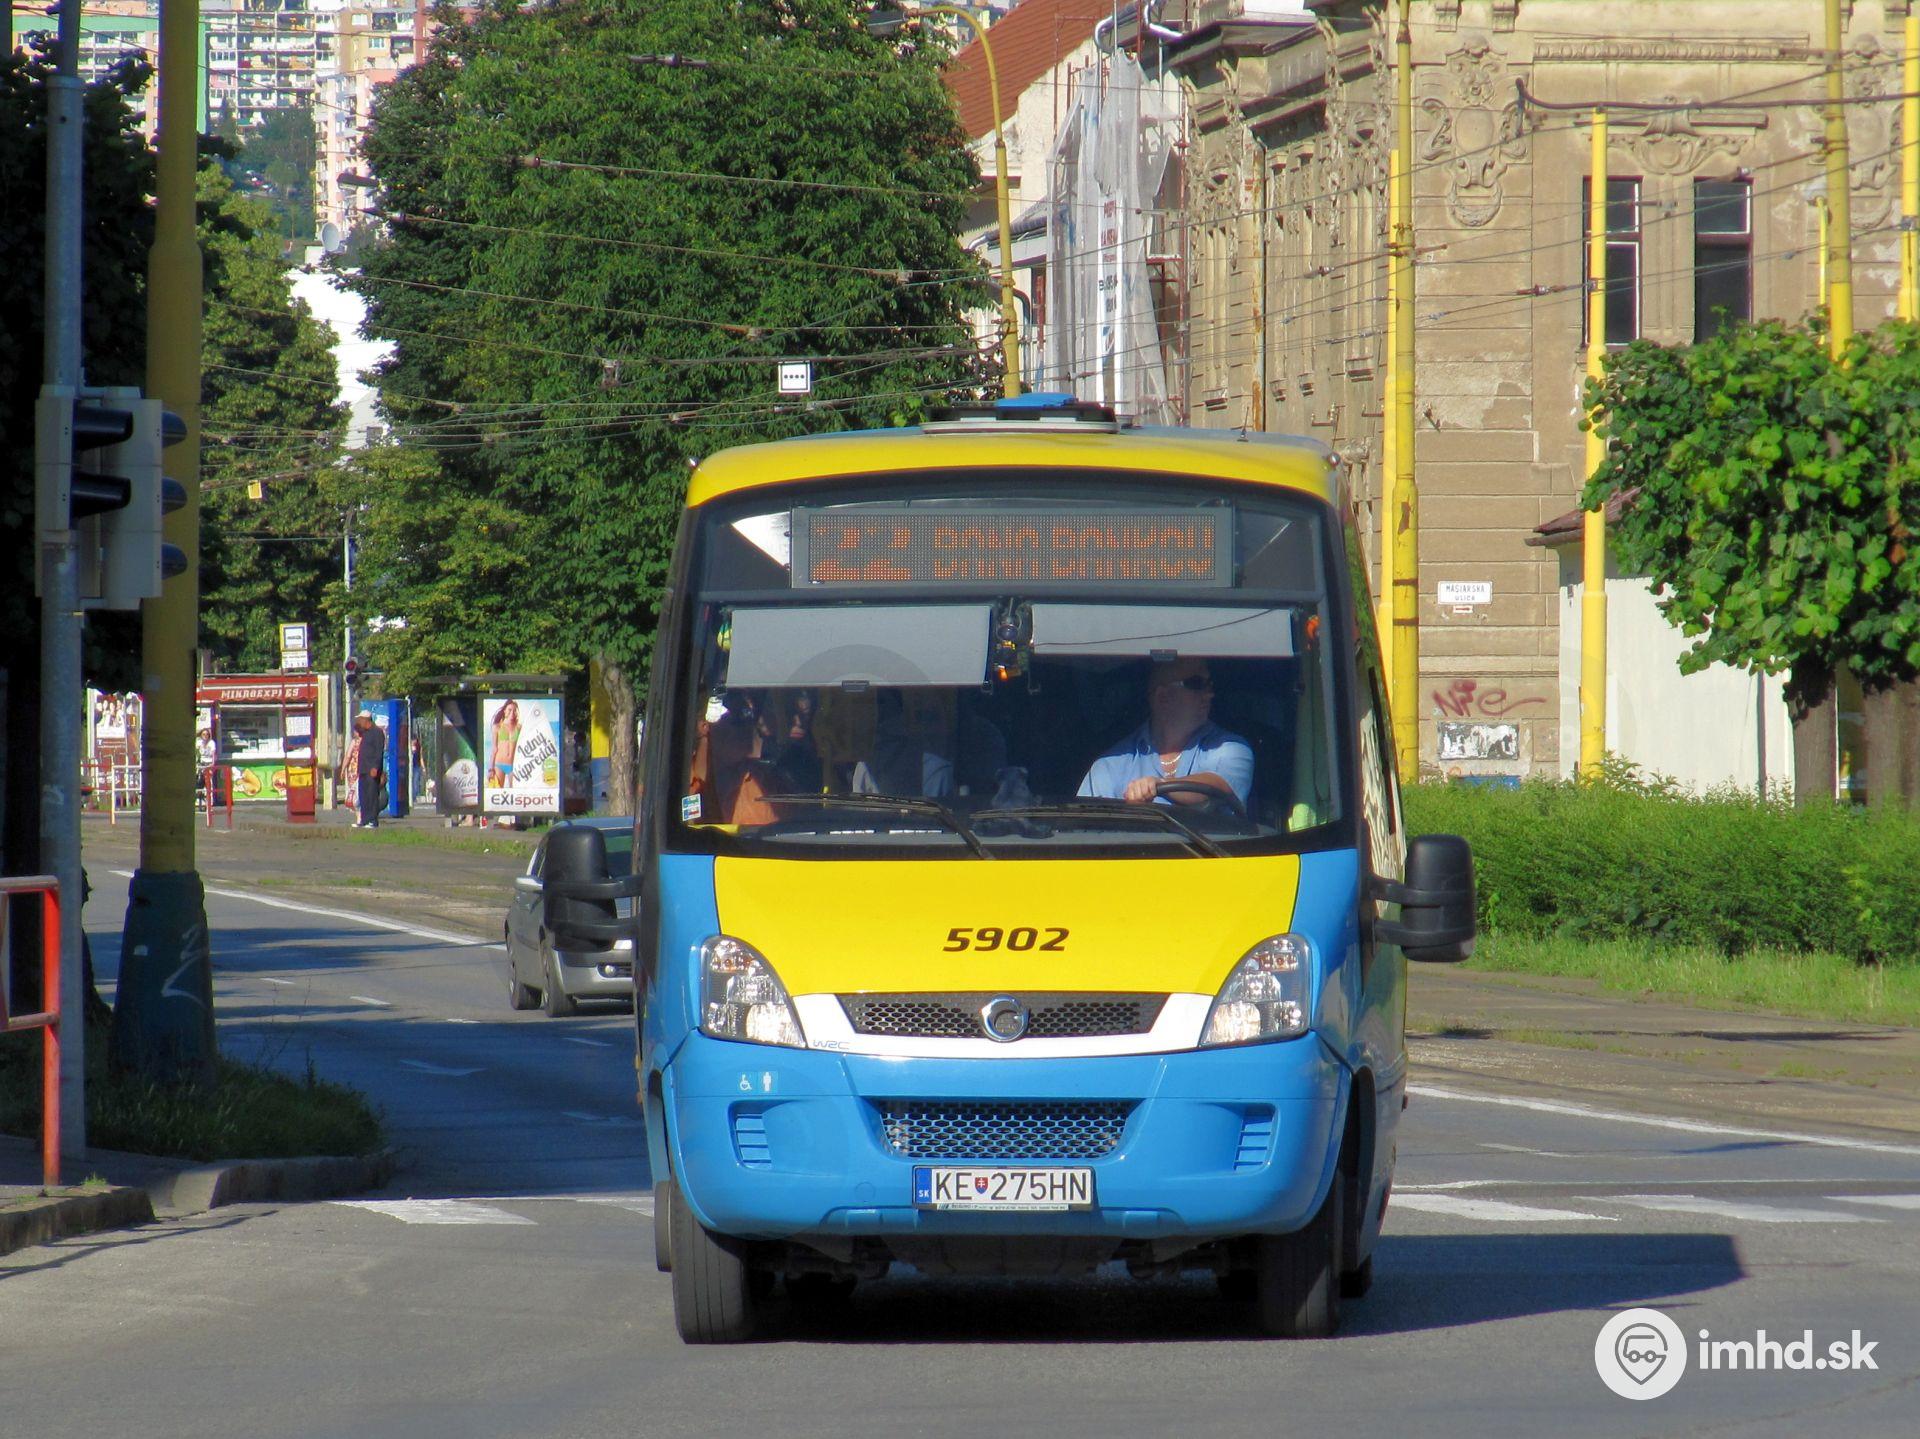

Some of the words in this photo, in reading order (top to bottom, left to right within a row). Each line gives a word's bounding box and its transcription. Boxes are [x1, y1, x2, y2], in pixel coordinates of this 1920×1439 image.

[943, 927, 1070, 952] 5902
[918, 1189, 930, 1198] SK
[935, 1172, 973, 1201] KE
[990, 1172, 1088, 1201] 275HN
